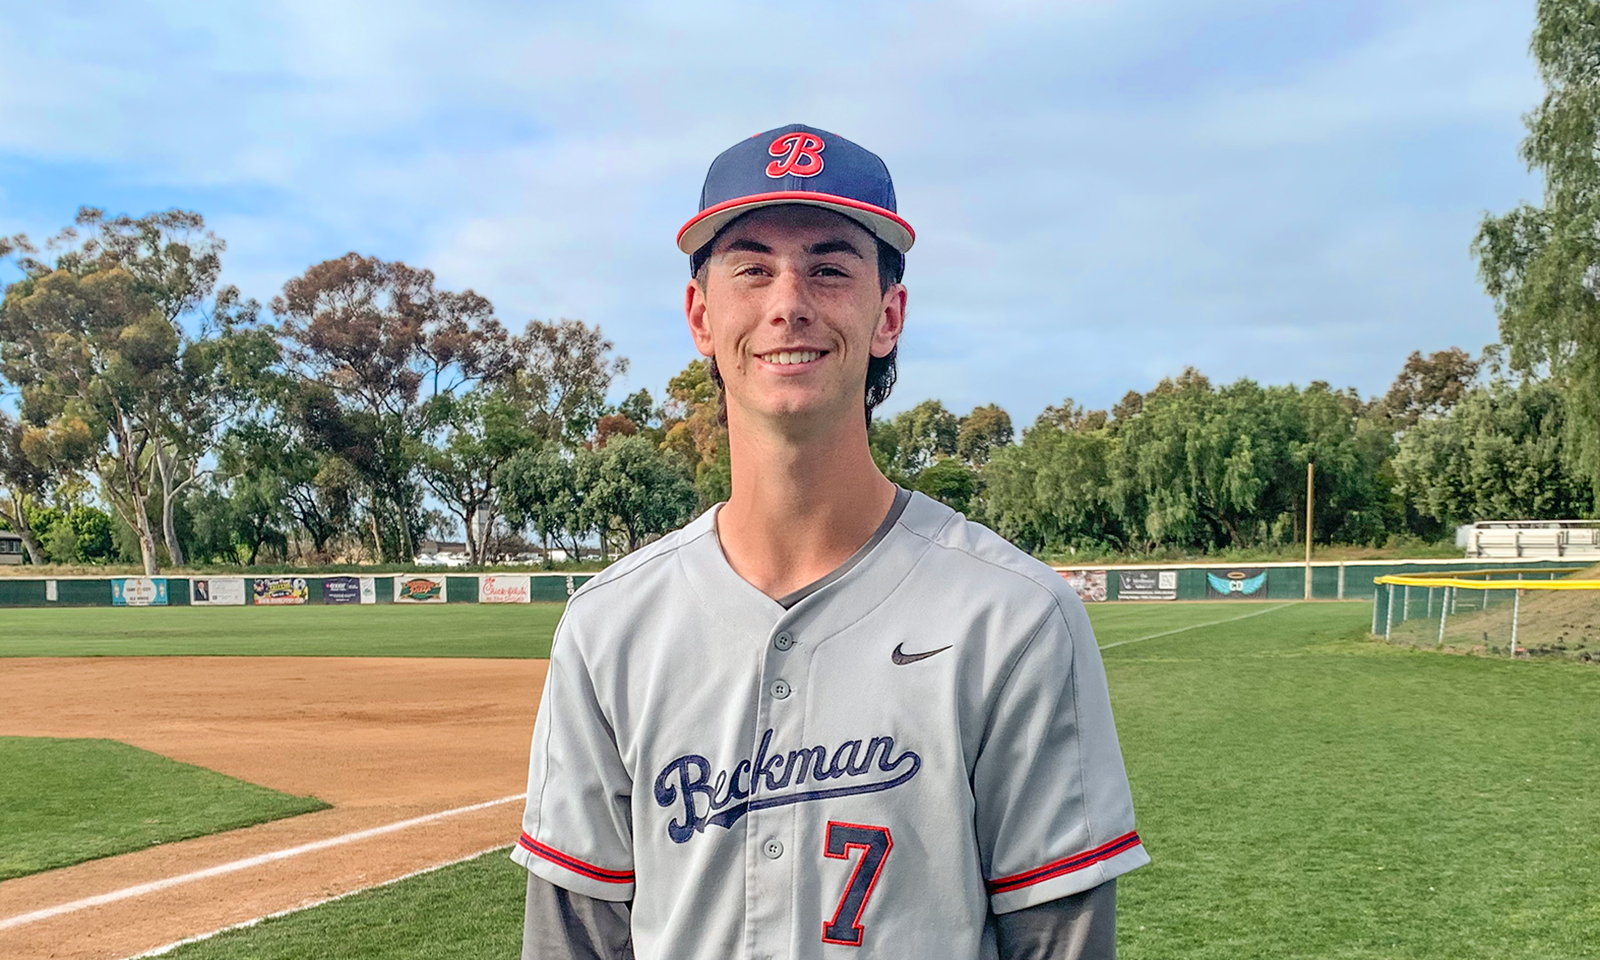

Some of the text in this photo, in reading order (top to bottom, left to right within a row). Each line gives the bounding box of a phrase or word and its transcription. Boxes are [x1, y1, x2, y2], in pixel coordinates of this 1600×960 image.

[765, 132, 825, 179] B
[654, 729, 921, 844] Beckman
[822, 820, 893, 947] 7
